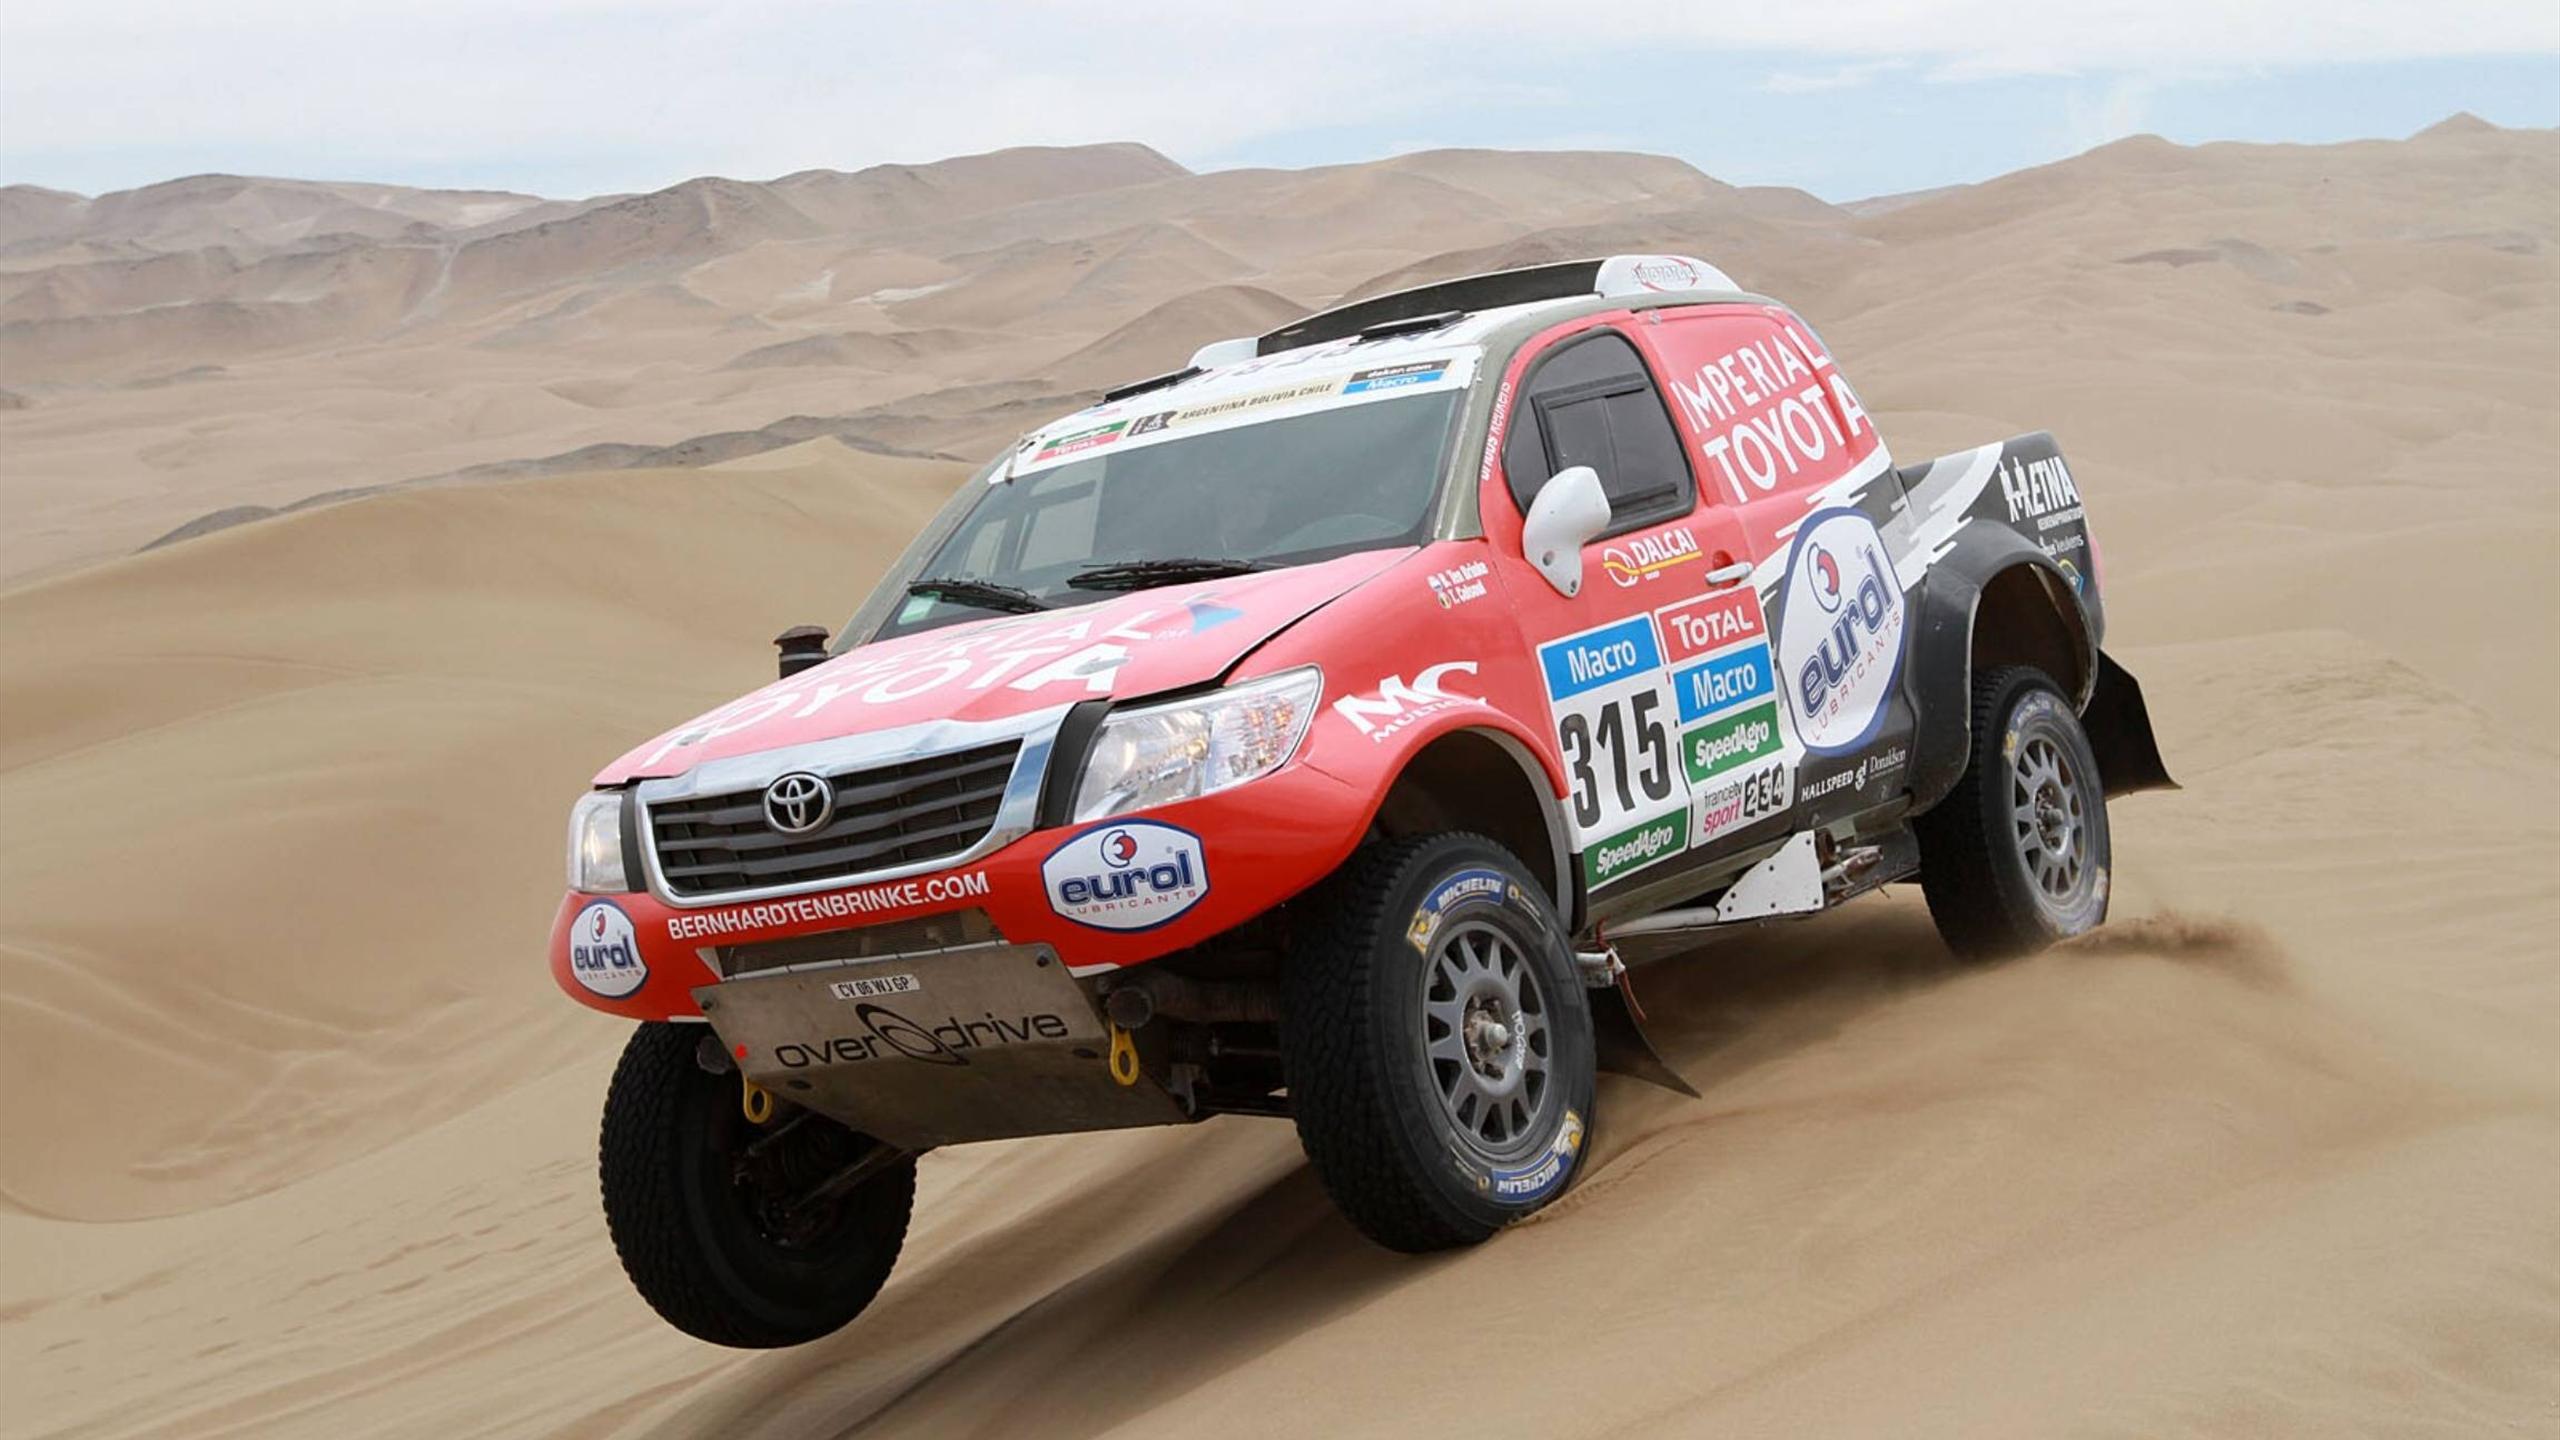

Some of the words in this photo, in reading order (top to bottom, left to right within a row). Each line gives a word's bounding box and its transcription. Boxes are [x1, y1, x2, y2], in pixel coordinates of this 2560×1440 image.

[1366, 375, 1419, 390] Macro
[1368, 363, 1433, 378] dakar.com
[1669, 325, 1831, 434] IMPERIAL
[1180, 400, 1247, 420] ARGENTINA
[1249, 390, 1295, 406] BOLIVIA
[1298, 383, 1333, 399] CHILE
[1702, 373, 1874, 503] TOYOTA
[1628, 527, 1699, 566] DALCAI
[1671, 606, 1755, 649] TOTAL
[1799, 544, 1895, 719] eurol
[1567, 639, 1637, 684] Macro
[1811, 610, 1902, 742] LUBRICANTS
[640, 642, 1129, 769] TOYOTA
[1332, 660, 1488, 735] MC
[1693, 663, 1757, 710] Macro
[1559, 688, 1672, 829] 315
[1695, 720, 1769, 769] SpeedAgro
[1703, 780, 1743, 808] francetv
[1801, 769, 1854, 801] HALLSPEED
[1869, 747, 1906, 774] Donaldson
[1703, 800, 1741, 834] sport
[1597, 825, 1673, 875] SpeedAgro
[1058, 849, 1195, 906] eurol
[1438, 877, 1502, 910] MICHELIN
[668, 871, 990, 940] BERNHARDTENBRINKE.COM
[1065, 891, 1197, 916] LUBRICANTS
[574, 932, 637, 971] eurol
[838, 983, 856, 998] CV
[892, 976, 909, 991] GP
[1497, 1157, 1561, 1194] MICHELIN
